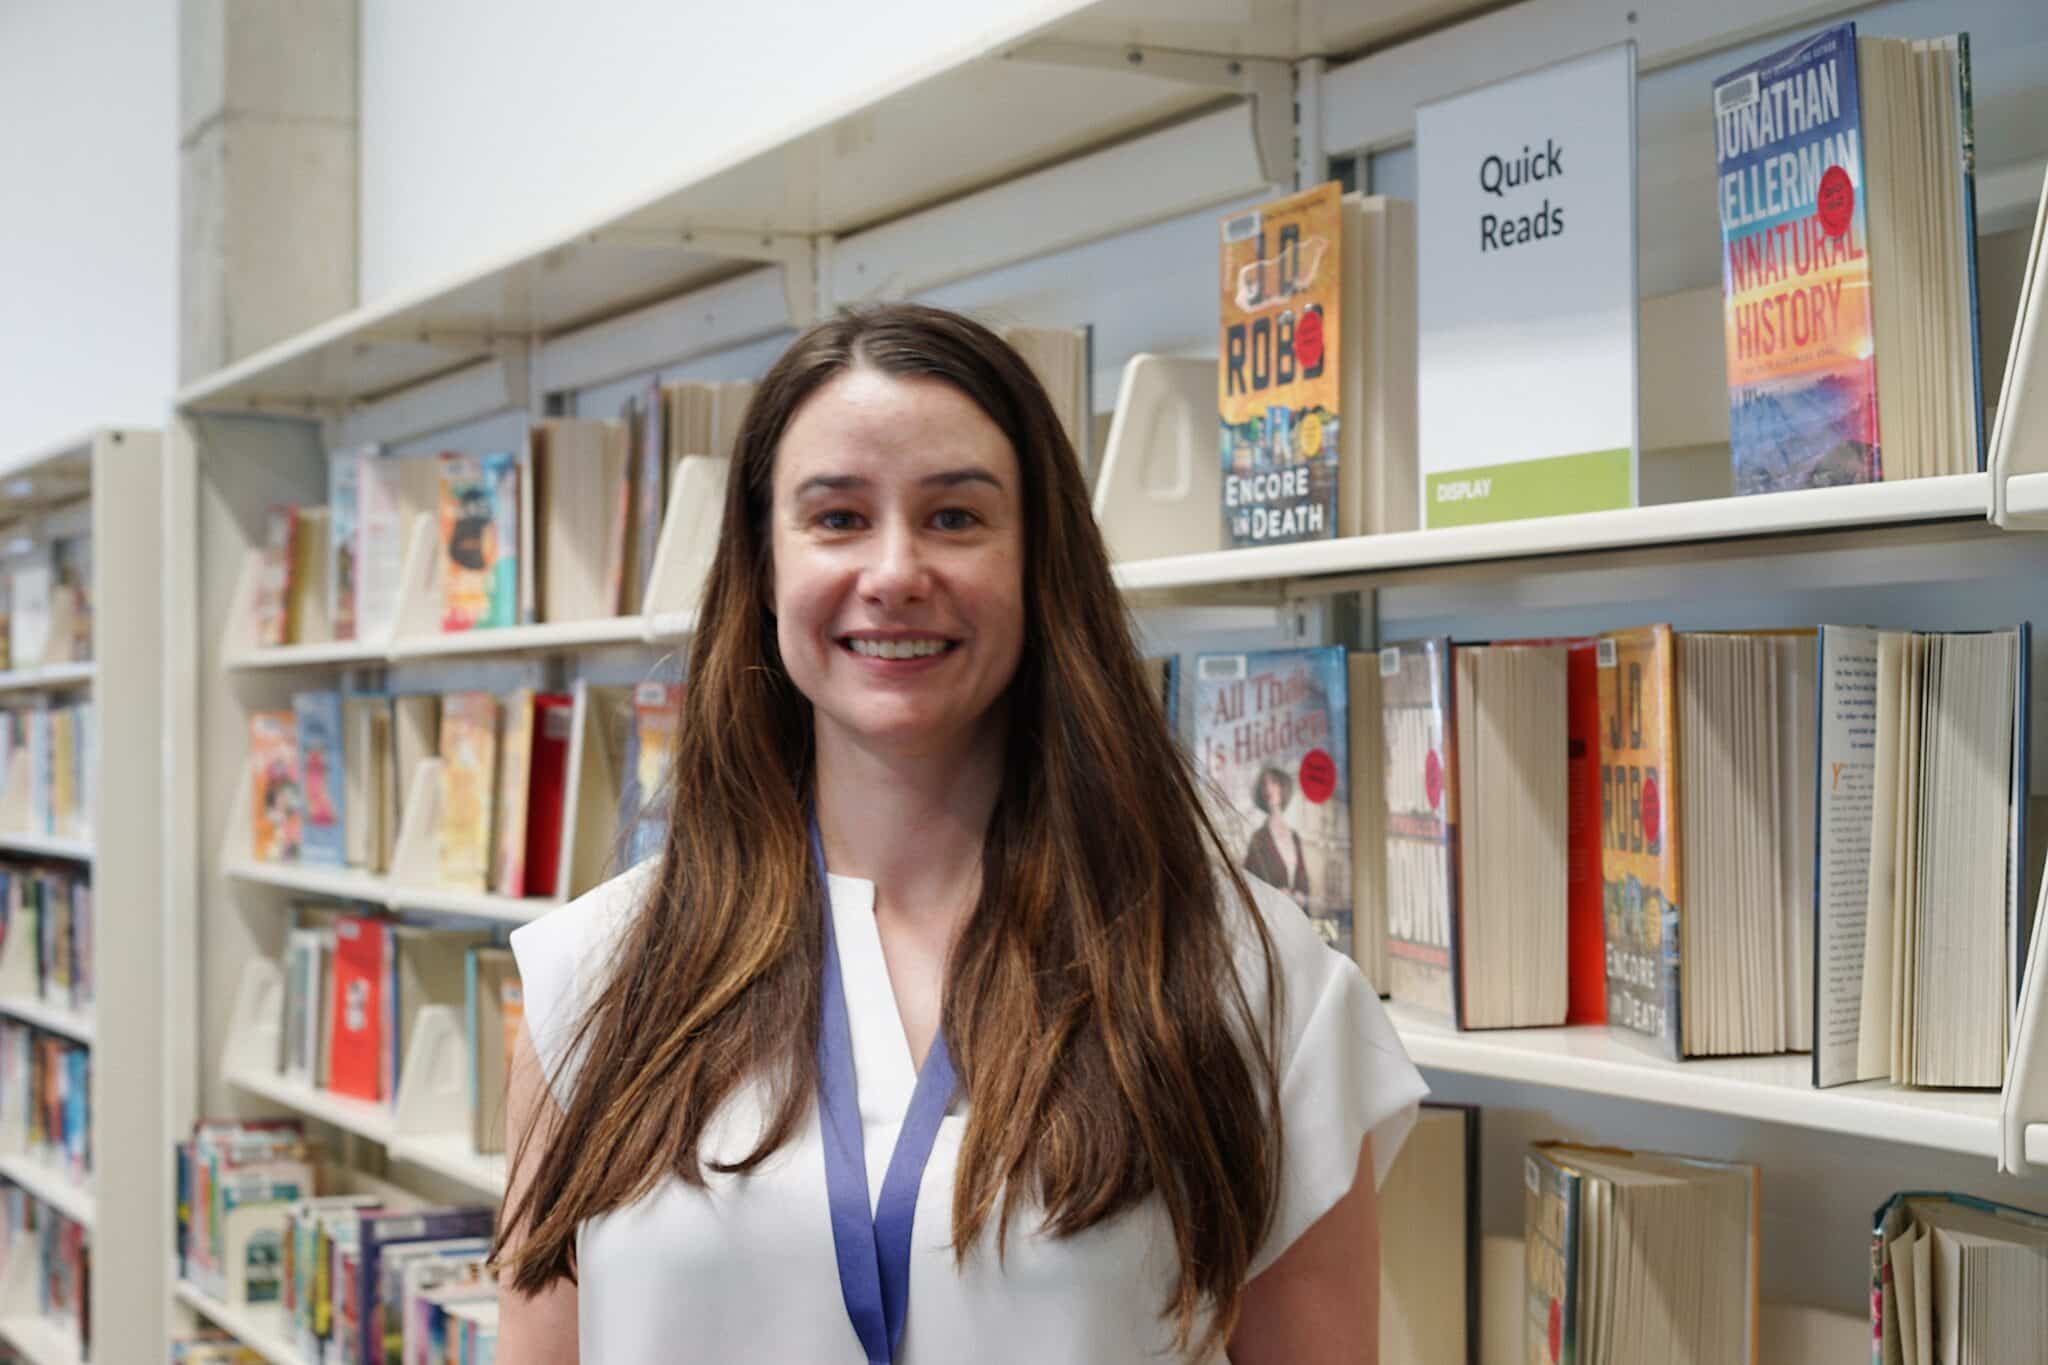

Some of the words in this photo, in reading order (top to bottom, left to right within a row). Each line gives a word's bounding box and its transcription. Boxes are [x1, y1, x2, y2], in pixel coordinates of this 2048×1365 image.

[1480, 138, 1563, 197] Quick
[1719, 129, 1860, 231] ELLERMAN
[1481, 198, 1564, 252] Reads
[1727, 213, 1863, 297] NNATURAL
[1735, 277, 1842, 361] HISTORY
[1225, 467, 1310, 507] ENCORE
[1436, 479, 1492, 501] DISPLAY
[1252, 503, 1324, 540] DEATH
[1233, 710, 1329, 766] Hidden
